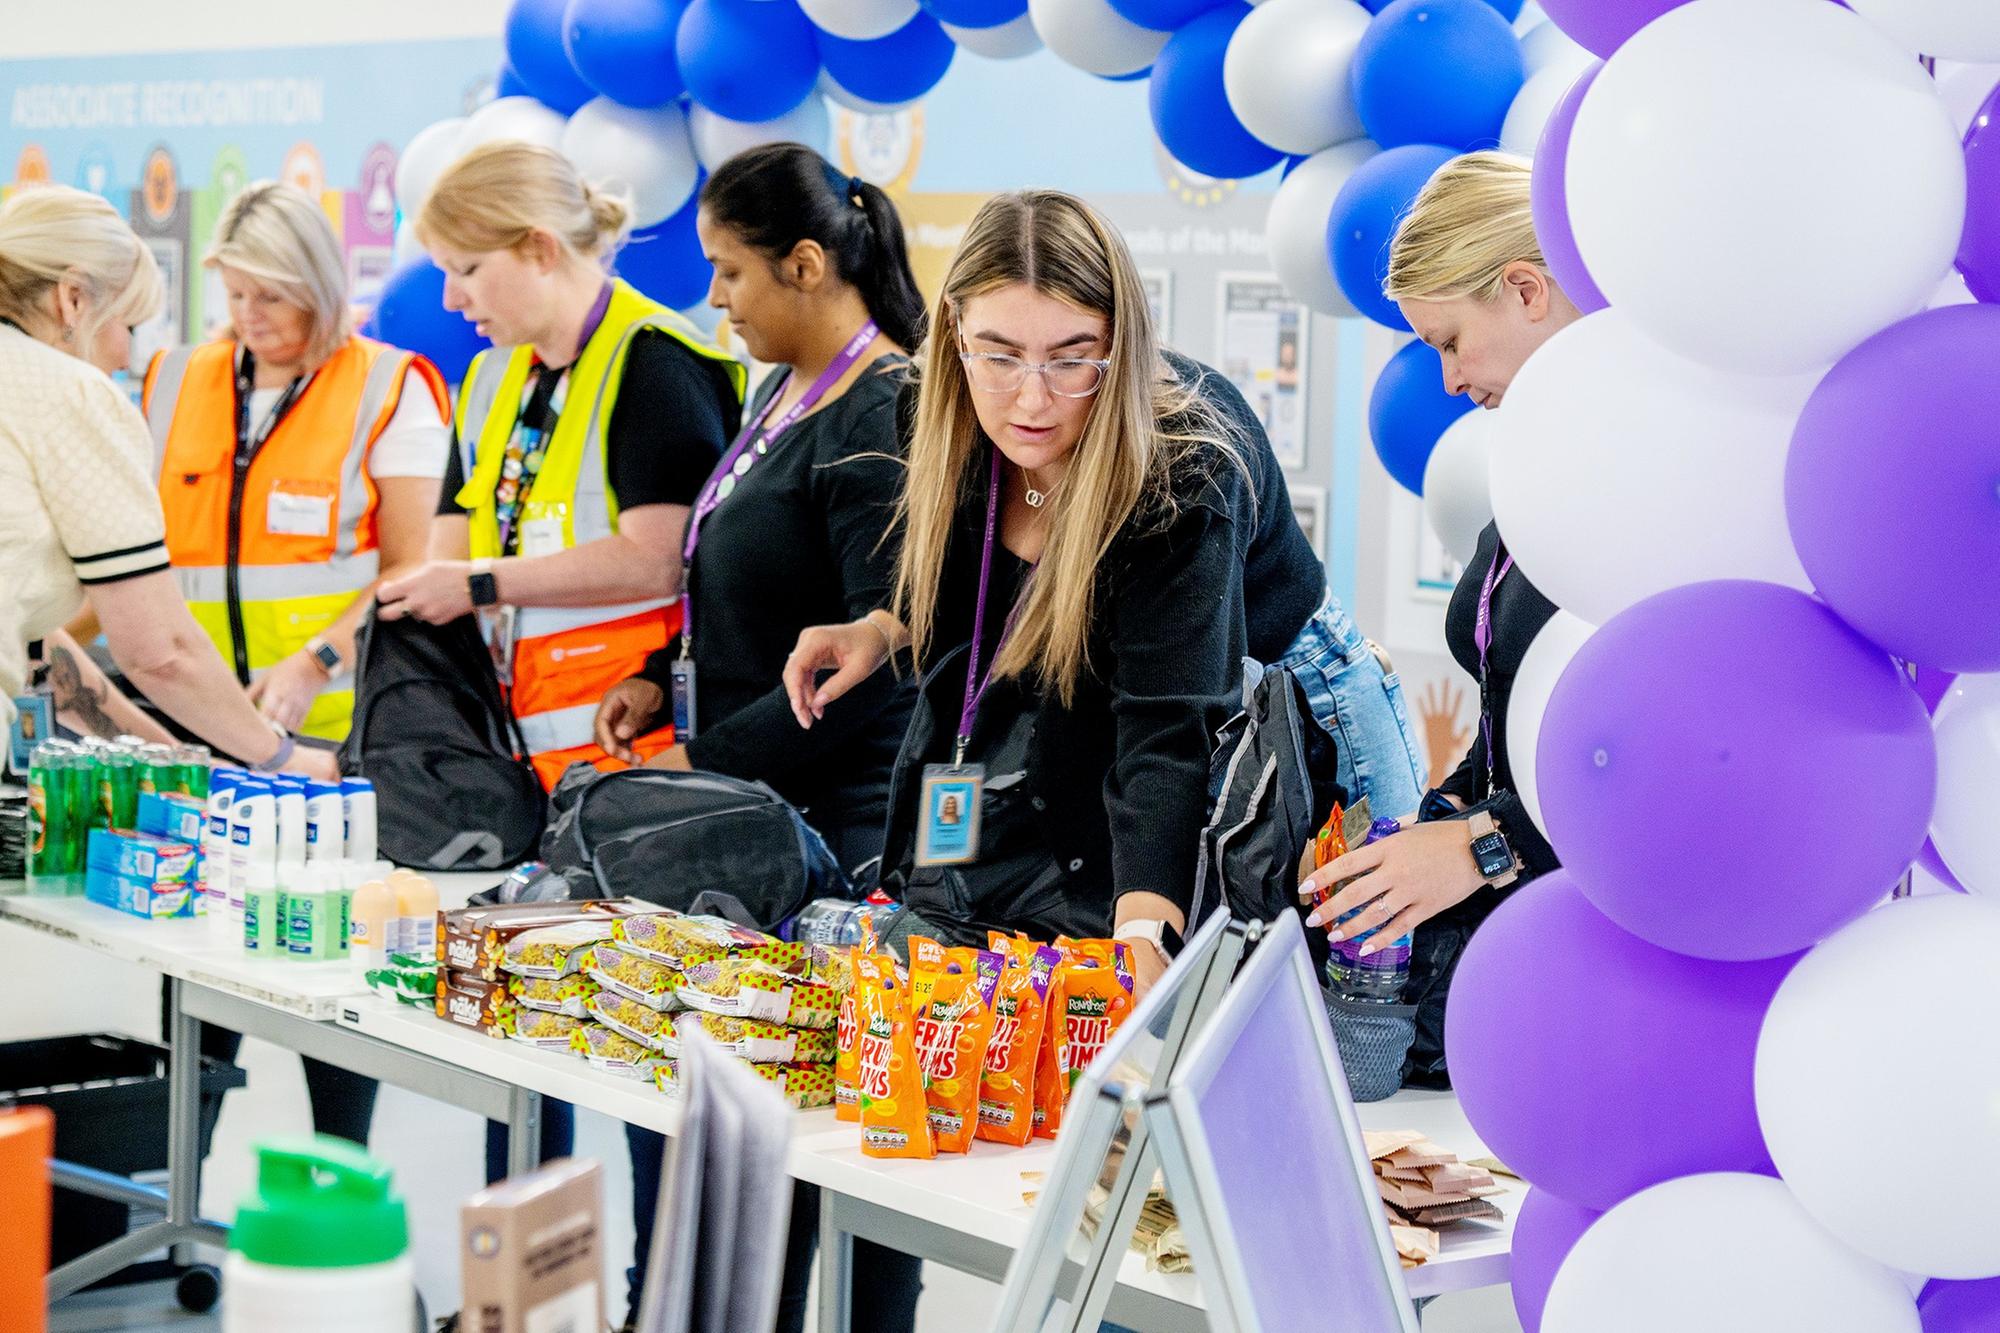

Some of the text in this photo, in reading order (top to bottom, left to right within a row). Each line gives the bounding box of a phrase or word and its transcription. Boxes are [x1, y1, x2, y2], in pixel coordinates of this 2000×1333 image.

[11, 79, 324, 128] ASSOCIATE RECOGNITION
[1478, 568, 1494, 626] HR Team
[1066, 1018, 1110, 1043] RUIT
